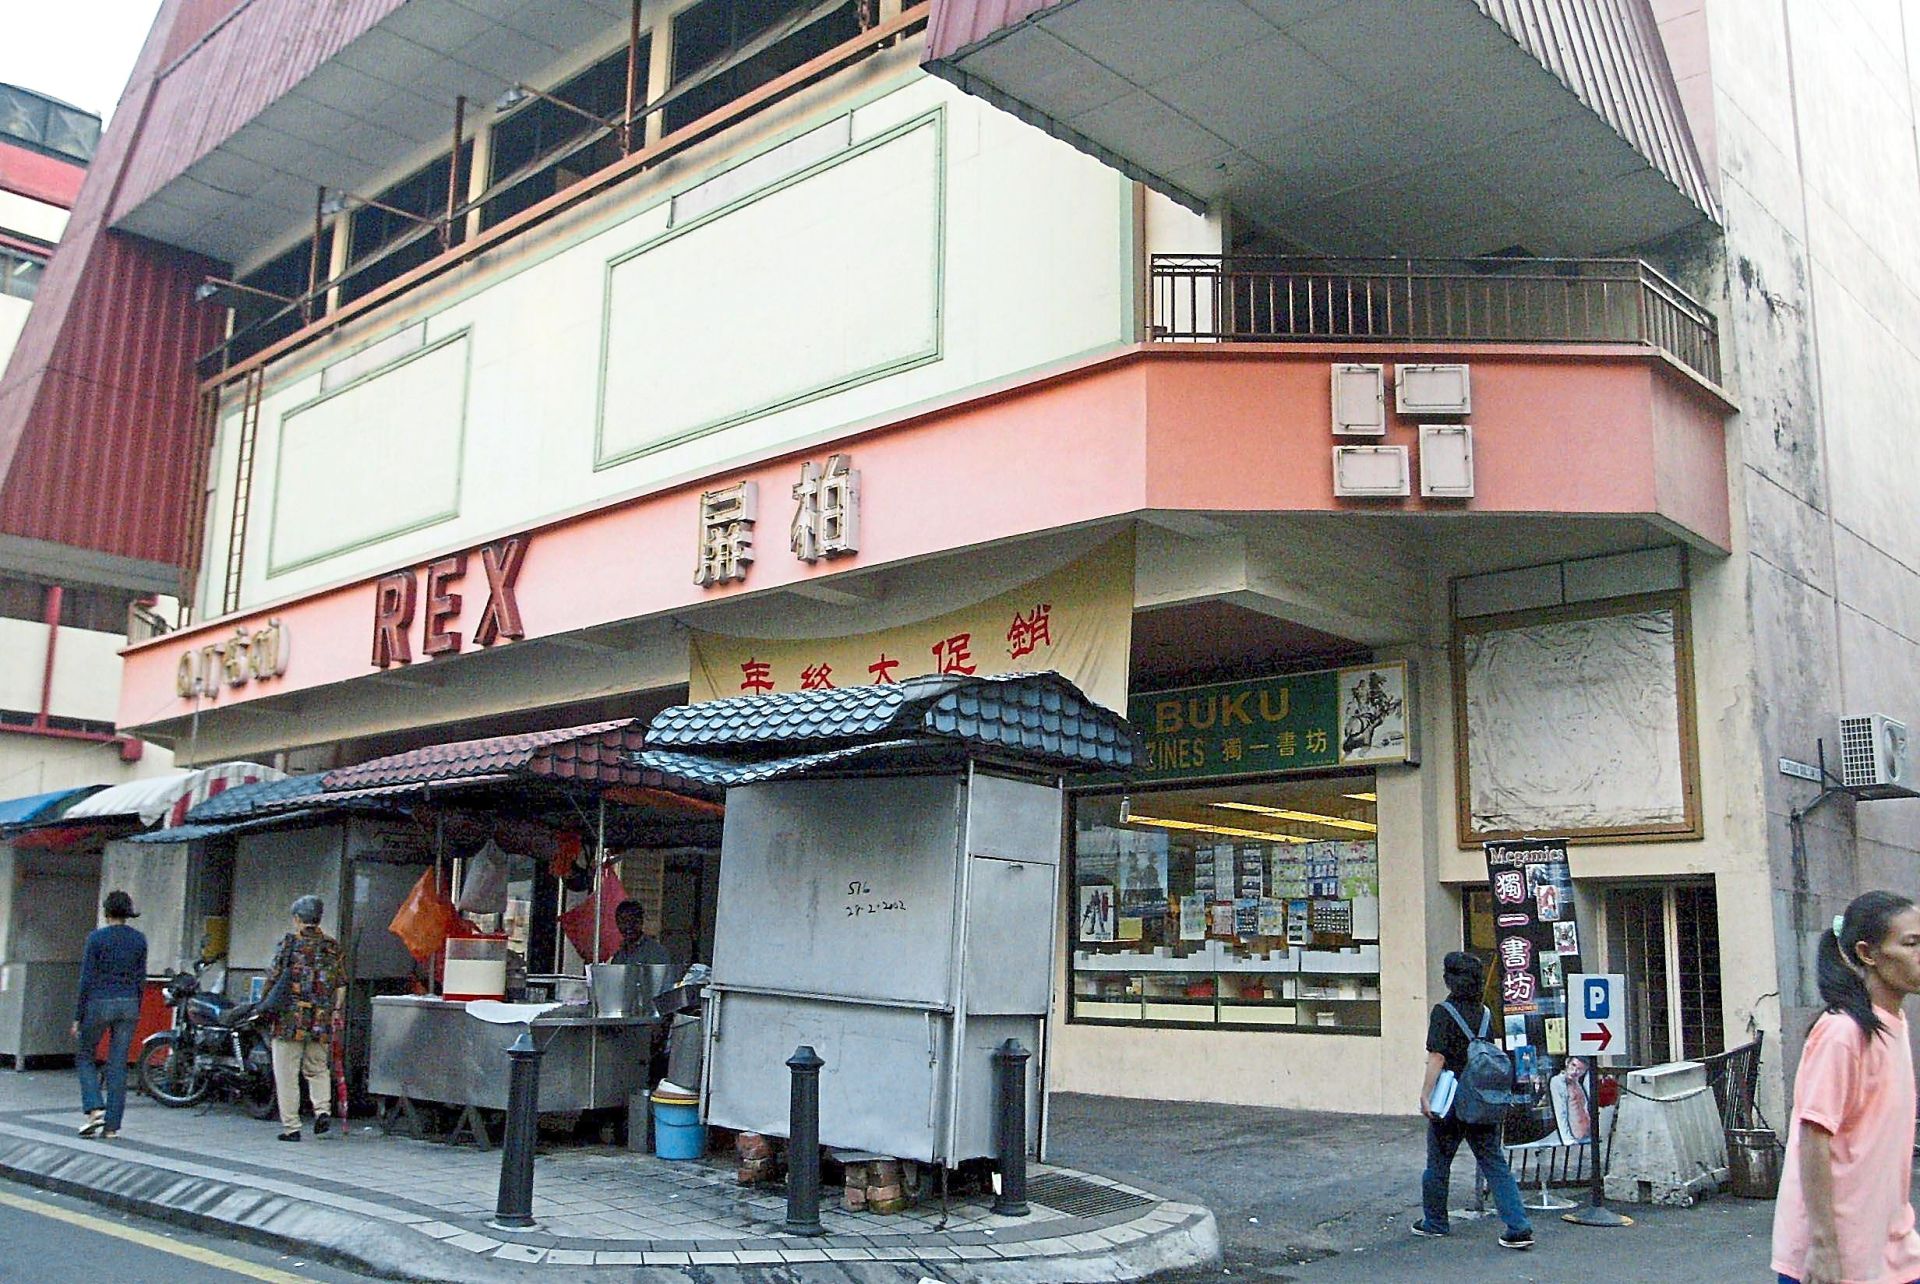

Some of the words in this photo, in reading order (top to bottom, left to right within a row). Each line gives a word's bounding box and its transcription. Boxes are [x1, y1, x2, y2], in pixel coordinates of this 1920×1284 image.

[371, 535, 533, 668] REX
[1156, 687, 1291, 734] BUKU
[1496, 872, 1534, 1001] 獨一書坊
[1589, 986, 1605, 1012] P
